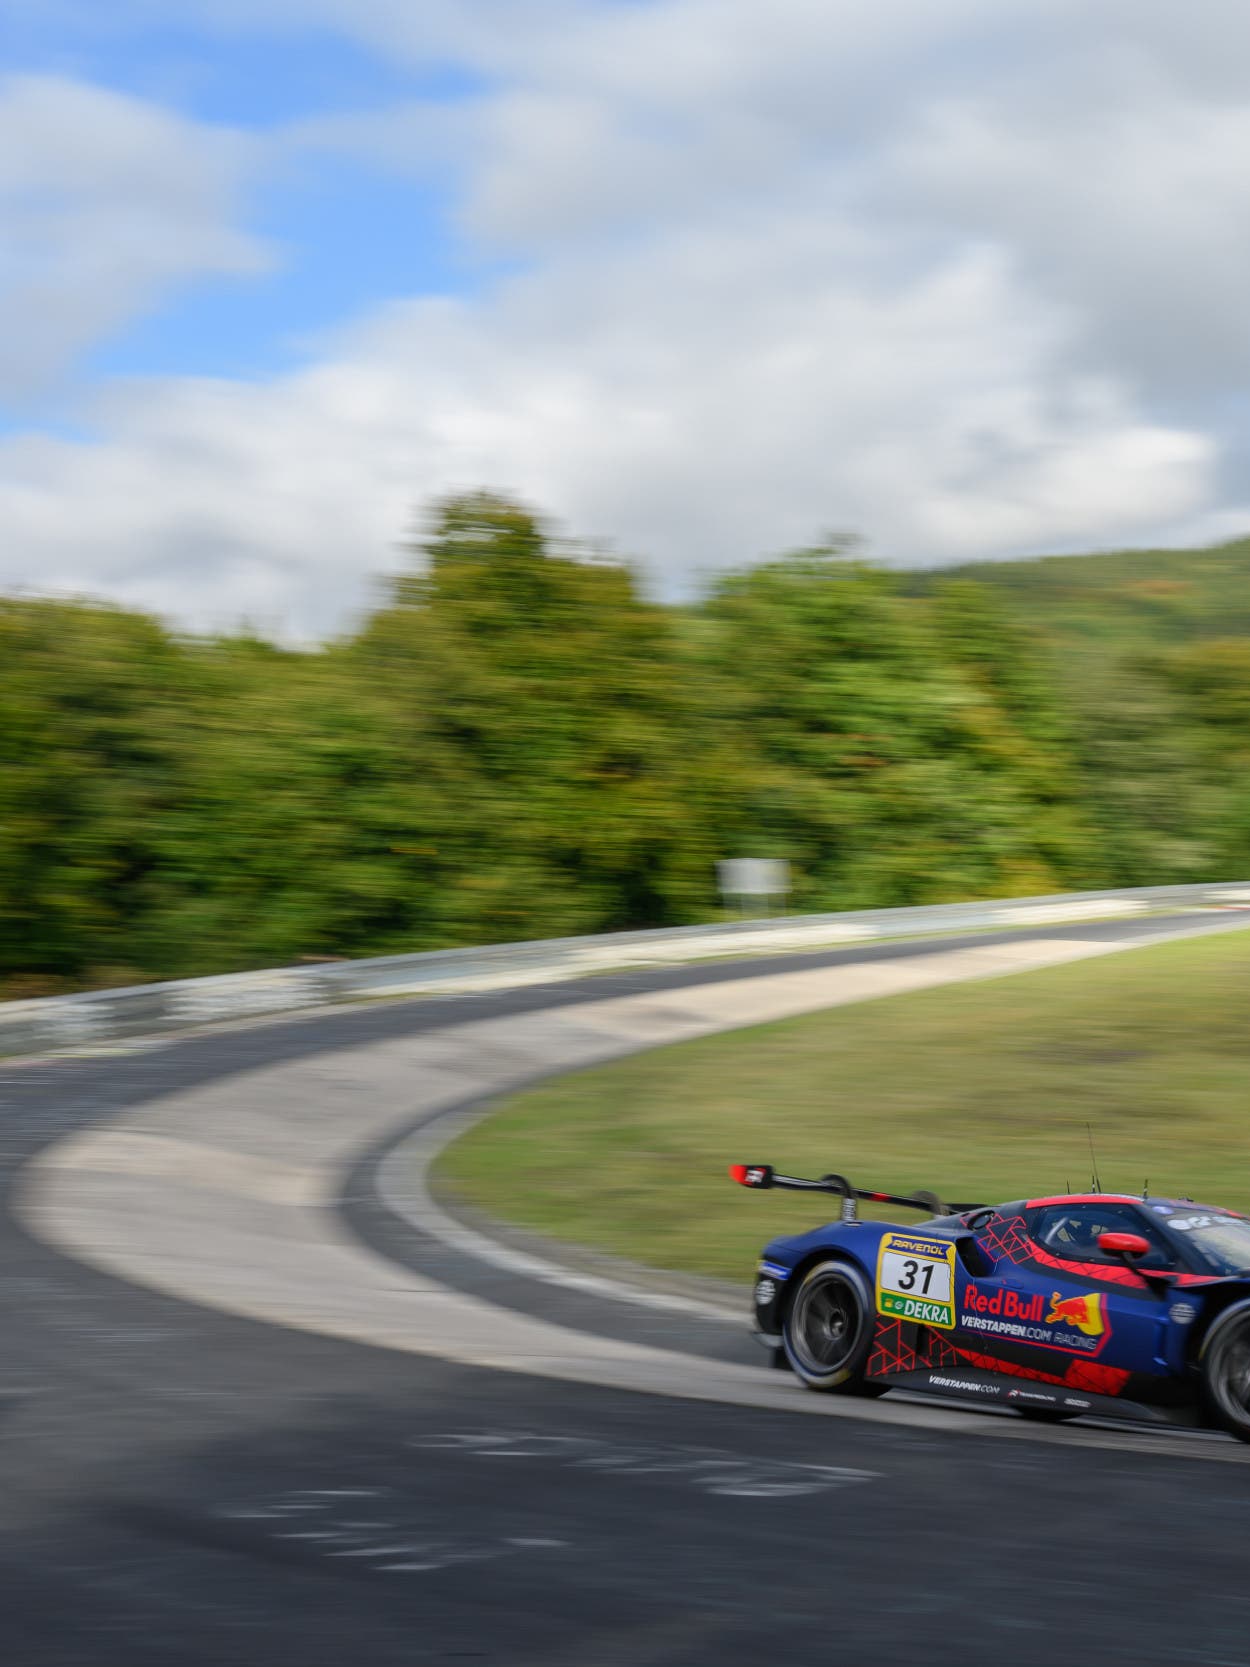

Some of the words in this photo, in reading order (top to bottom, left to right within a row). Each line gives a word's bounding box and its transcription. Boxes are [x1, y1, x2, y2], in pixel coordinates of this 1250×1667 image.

[898, 1260, 934, 1294] 31
[904, 1300, 949, 1324] DEKRA
[964, 1284, 1003, 1315] Red
[1004, 1291, 1045, 1322] Bull
[961, 1315, 1052, 1341] VERSTAPPEN.COM
